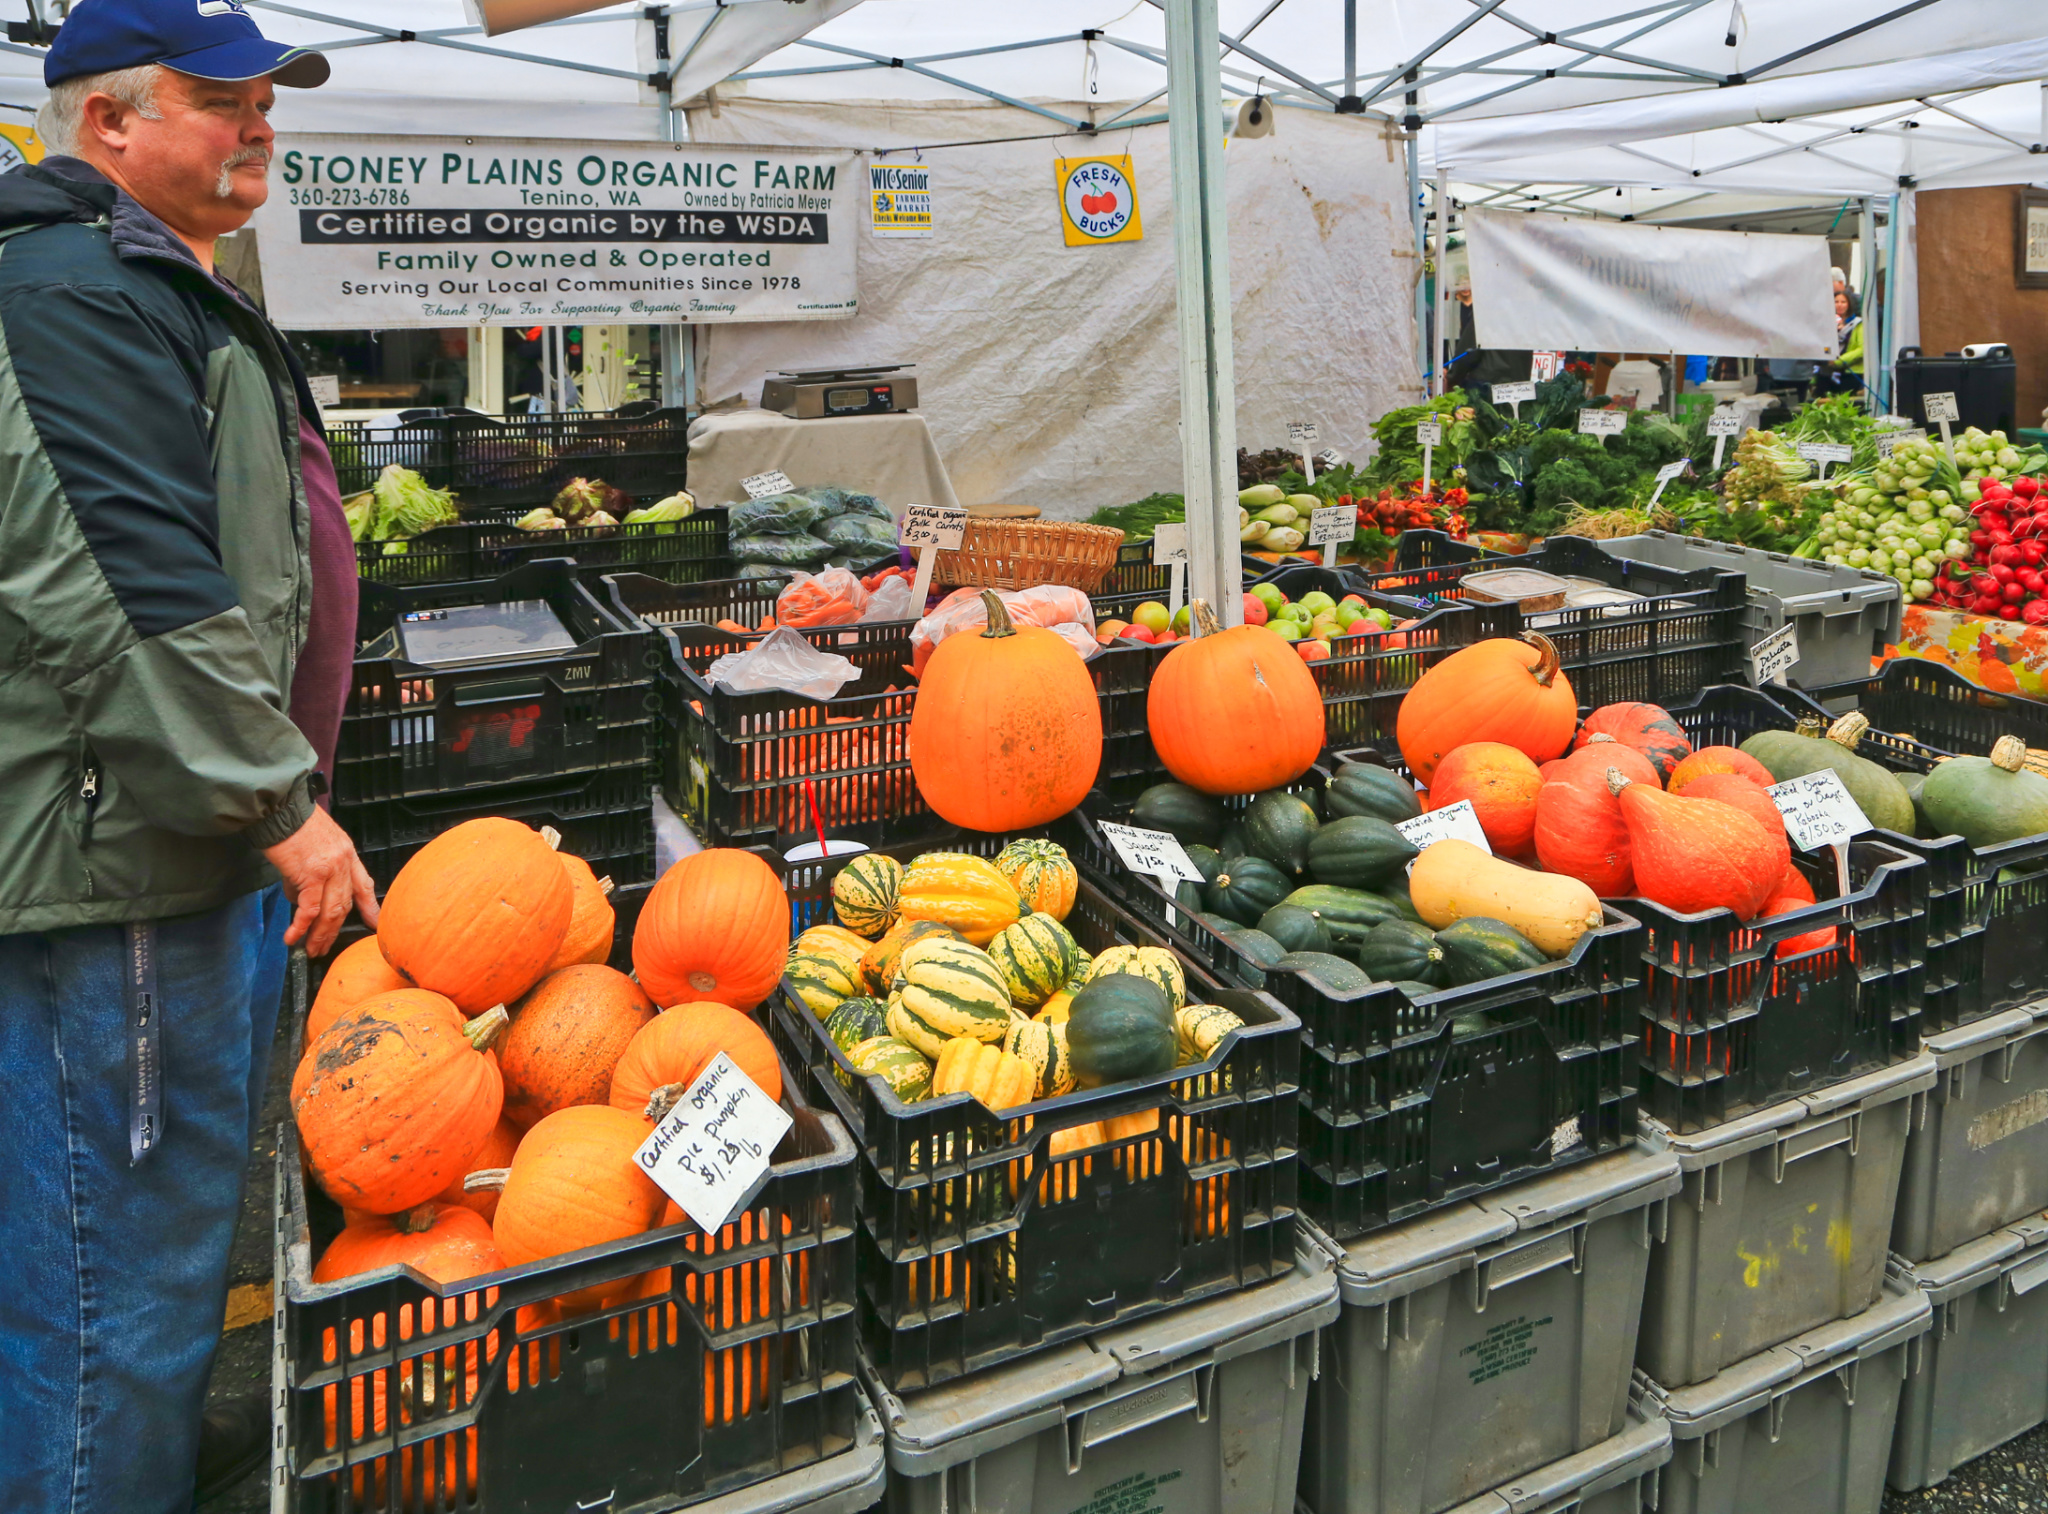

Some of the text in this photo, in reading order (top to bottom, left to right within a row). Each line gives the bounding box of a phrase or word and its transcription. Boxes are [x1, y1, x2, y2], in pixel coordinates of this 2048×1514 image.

[283, 150, 836, 191] STONEY PLAINS ORGANIC FARM
[870, 168, 893, 190] WIC
[896, 168, 929, 190] Senior
[1072, 167, 1121, 189] FRESH
[290, 188, 410, 206] 360-273-6786
[520, 189, 642, 208] Tenino, WA
[684, 191, 832, 213] Owned by Patricia Meyer
[896, 194, 930, 203] FARMERS
[896, 203, 930, 213] MARKET
[316, 212, 815, 239] Certified Organic by the WSDA
[1080, 211, 1125, 233] BUCKS
[378, 249, 771, 273] Family Owned & Operated
[341, 276, 801, 298] Serving Our Local Communities Since 1978
[421, 299, 738, 319] Thank You For Supporting Organic Farming
[908, 506, 940, 519] Certified
[909, 517, 965, 532] Bulk Carrots
[564, 665, 591, 681] ZMV
[1438, 804, 1469, 822] Organic
[1102, 822, 1139, 839] Certified
[1799, 823, 1830, 847] $1.50
[1121, 837, 1163, 853] Squash
[677, 1086, 751, 1175] Pie Pumpkin
[641, 1116, 690, 1169] Certified
[738, 1137, 763, 1160] lb
[1117, 1388, 1168, 1416] BUCKHORN
